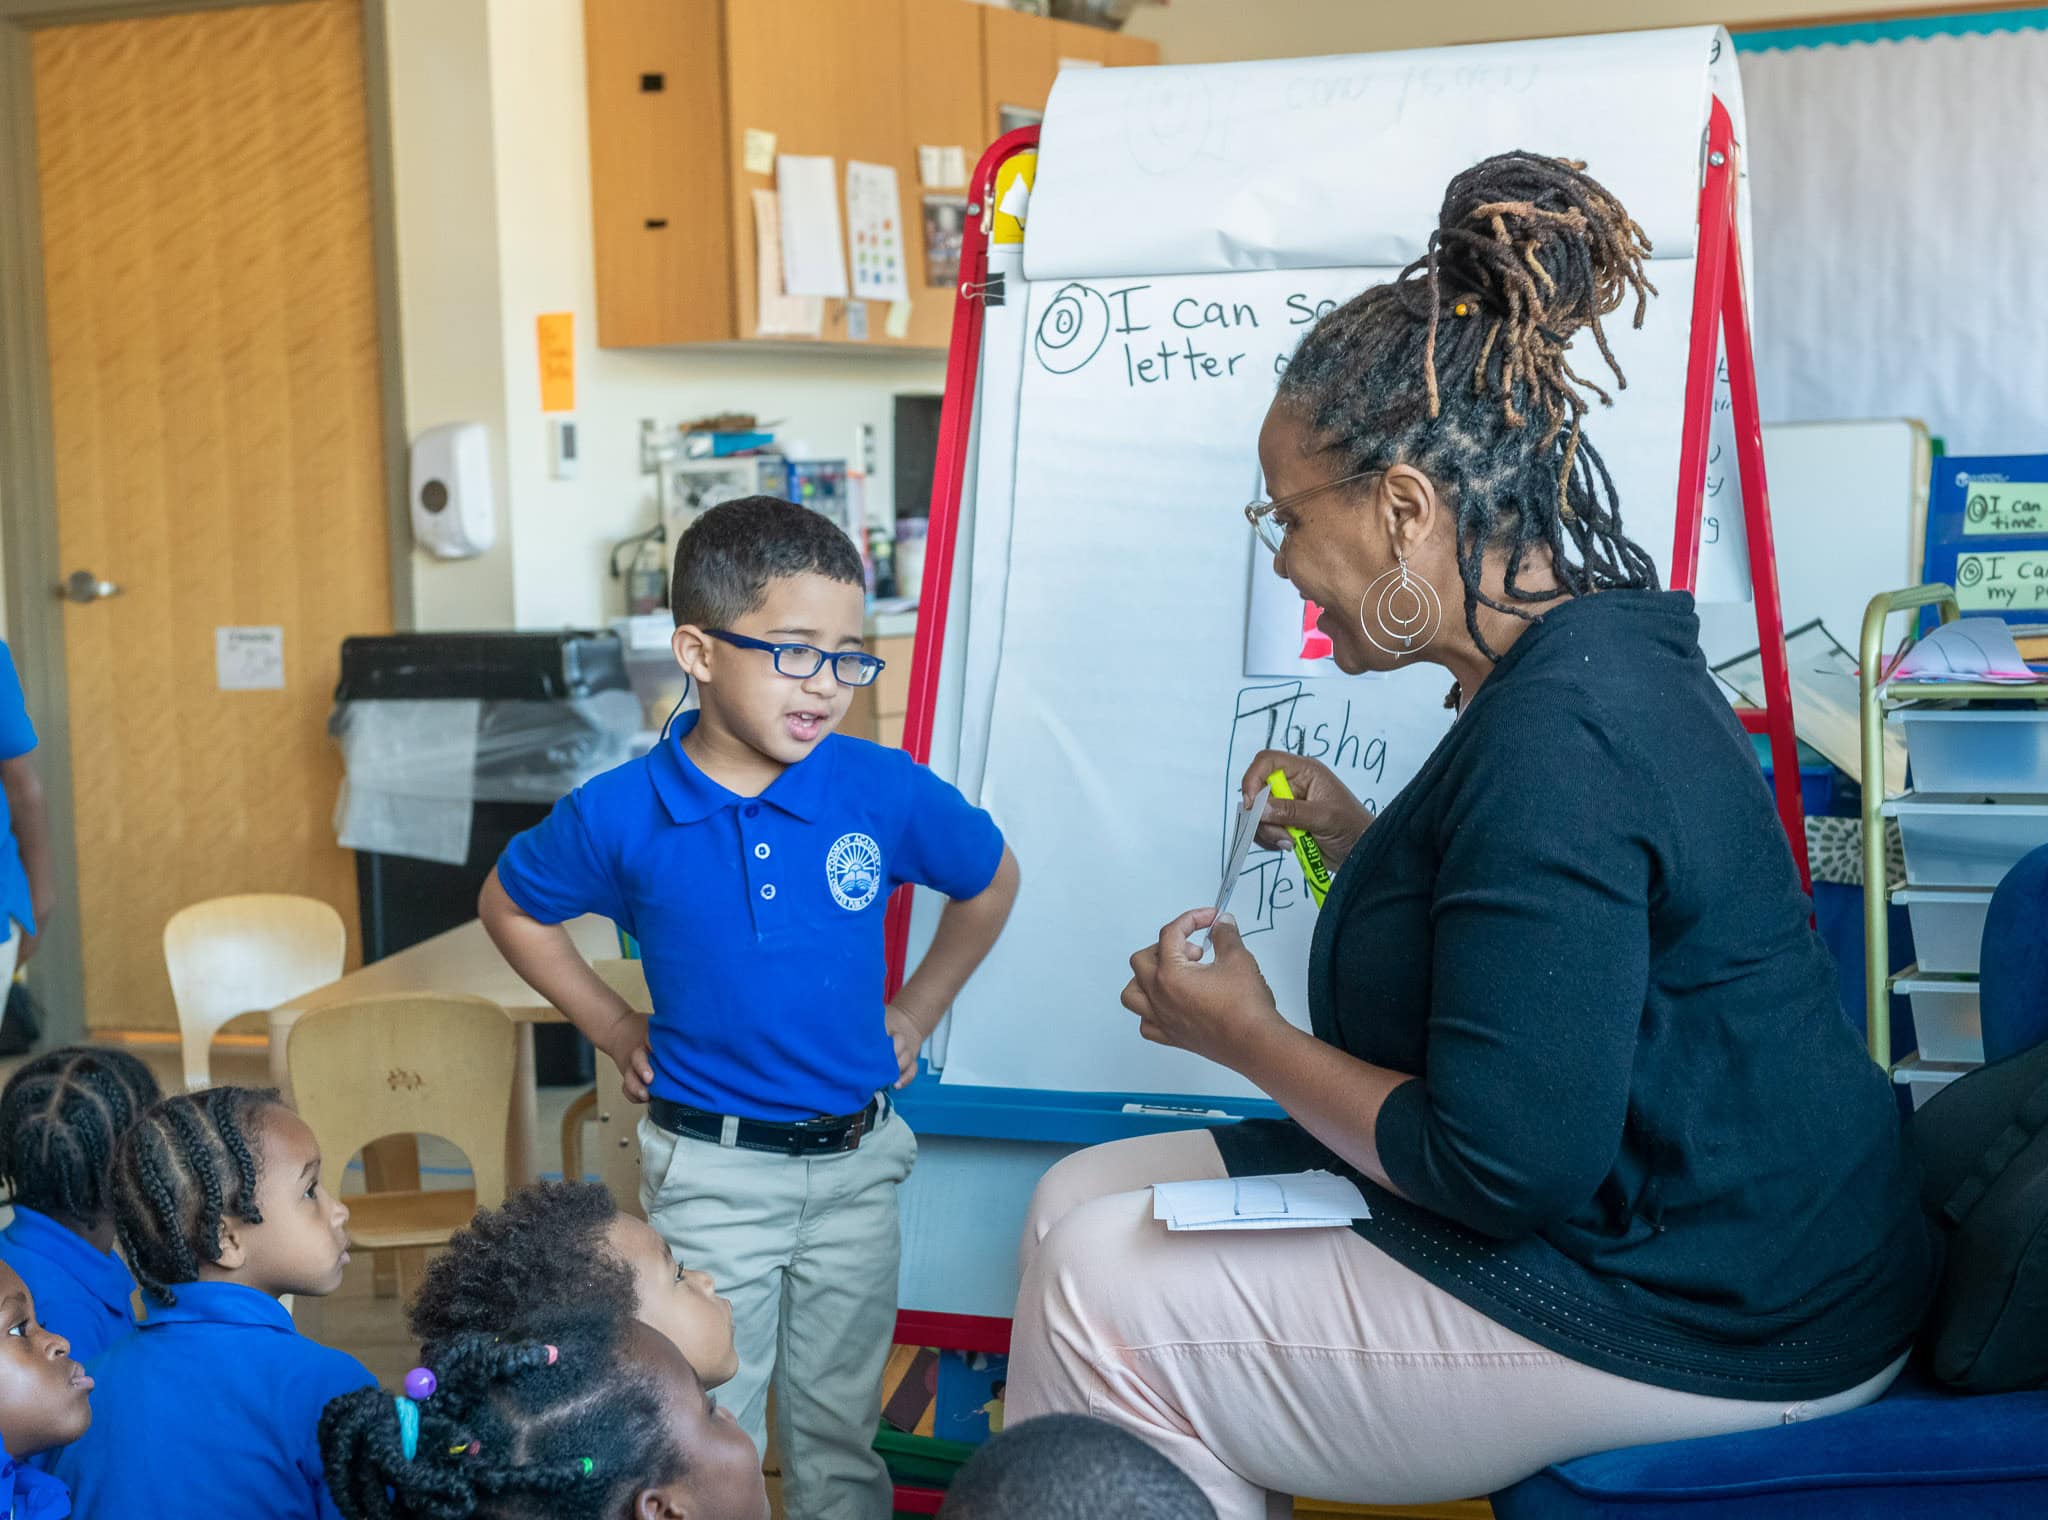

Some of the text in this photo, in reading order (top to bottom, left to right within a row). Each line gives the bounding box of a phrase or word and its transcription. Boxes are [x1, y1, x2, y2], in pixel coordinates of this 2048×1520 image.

[1108, 284, 1152, 335] I
[1172, 297, 1260, 329] can
[1123, 336, 1247, 387] letter
[1988, 495, 2042, 515] I can
[1985, 556, 2005, 581] I
[1986, 587, 2017, 608] my
[1236, 692, 1389, 785] Tasha
